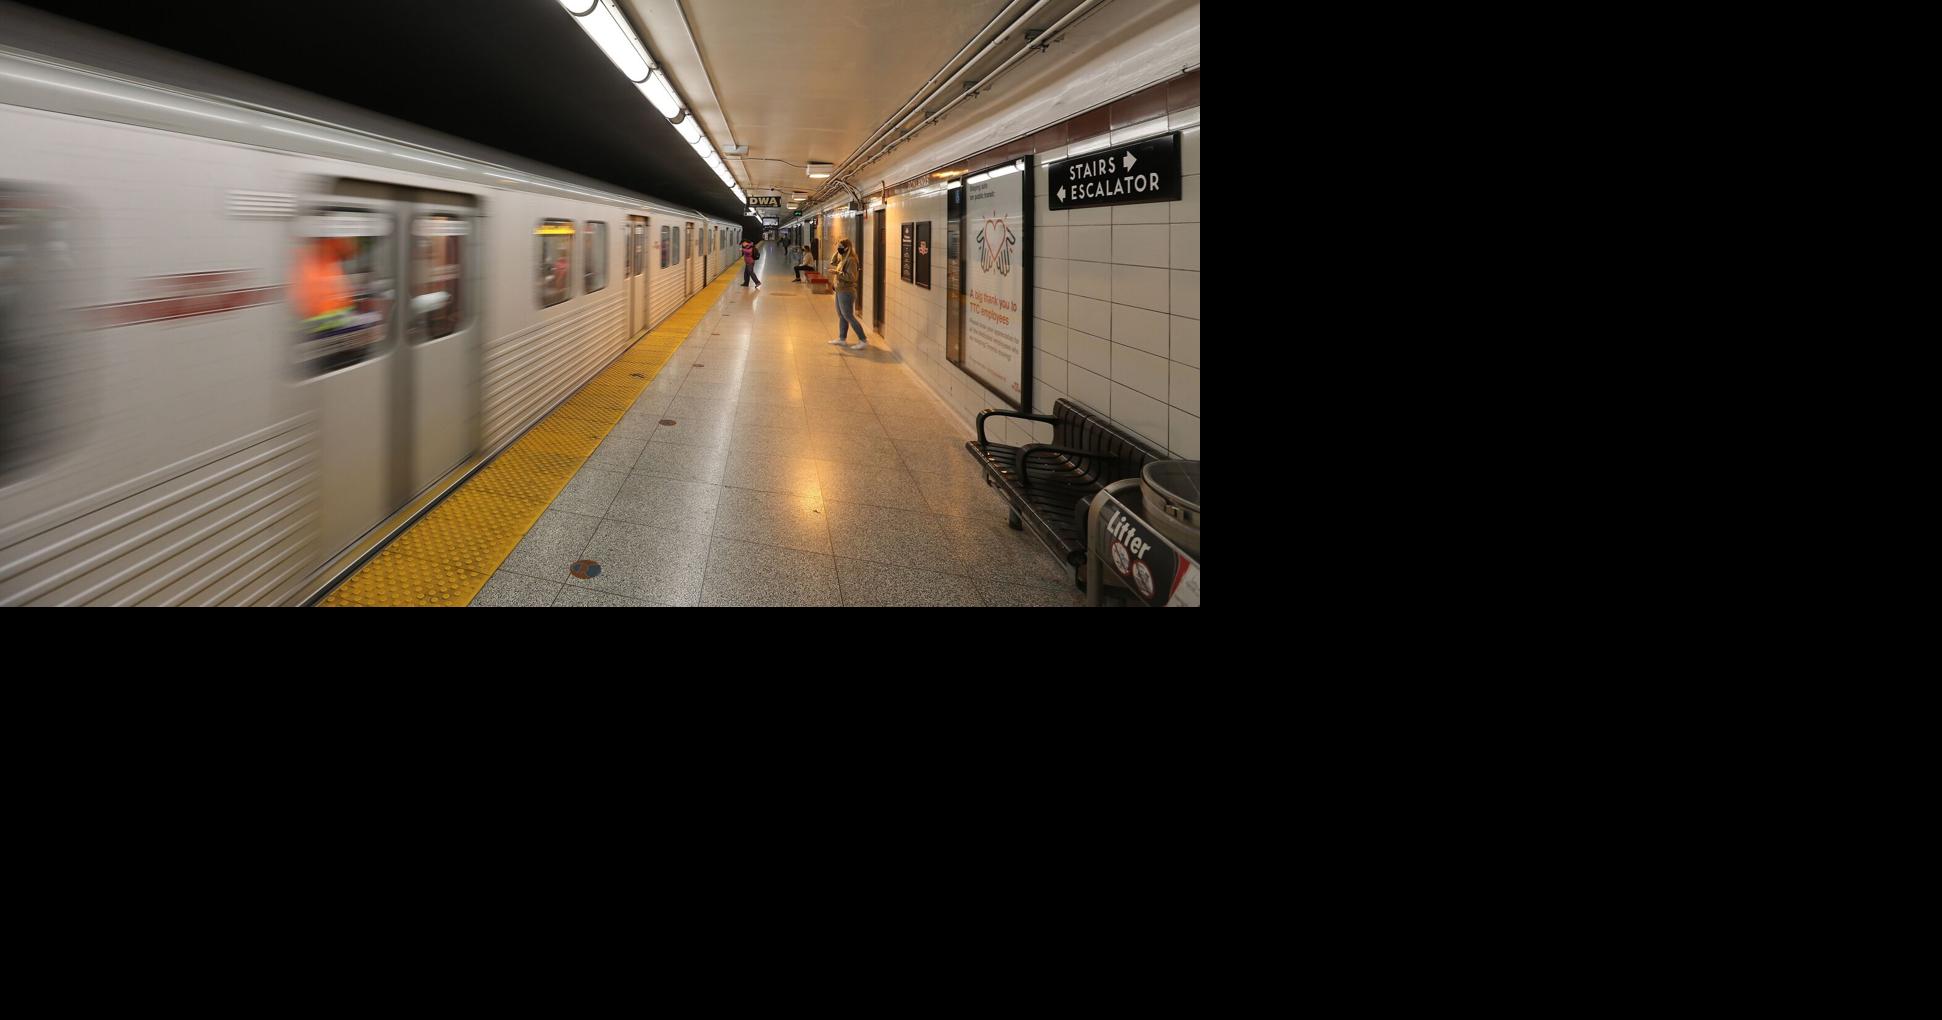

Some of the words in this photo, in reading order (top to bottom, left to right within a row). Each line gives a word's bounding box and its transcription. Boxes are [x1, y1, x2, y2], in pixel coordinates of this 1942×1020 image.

[1069, 156, 1116, 181] STAIRS
[1071, 172, 1160, 200] ESCALATOR
[749, 197, 777, 205] DWA
[969, 289, 974, 298] A
[975, 290, 983, 303] big
[984, 293, 998, 305] thank
[999, 300, 1009, 310] you
[1011, 300, 1017, 312] to
[970, 302, 980, 314] TTC
[981, 308, 1009, 326] employees
[1106, 510, 1151, 560] Litter
